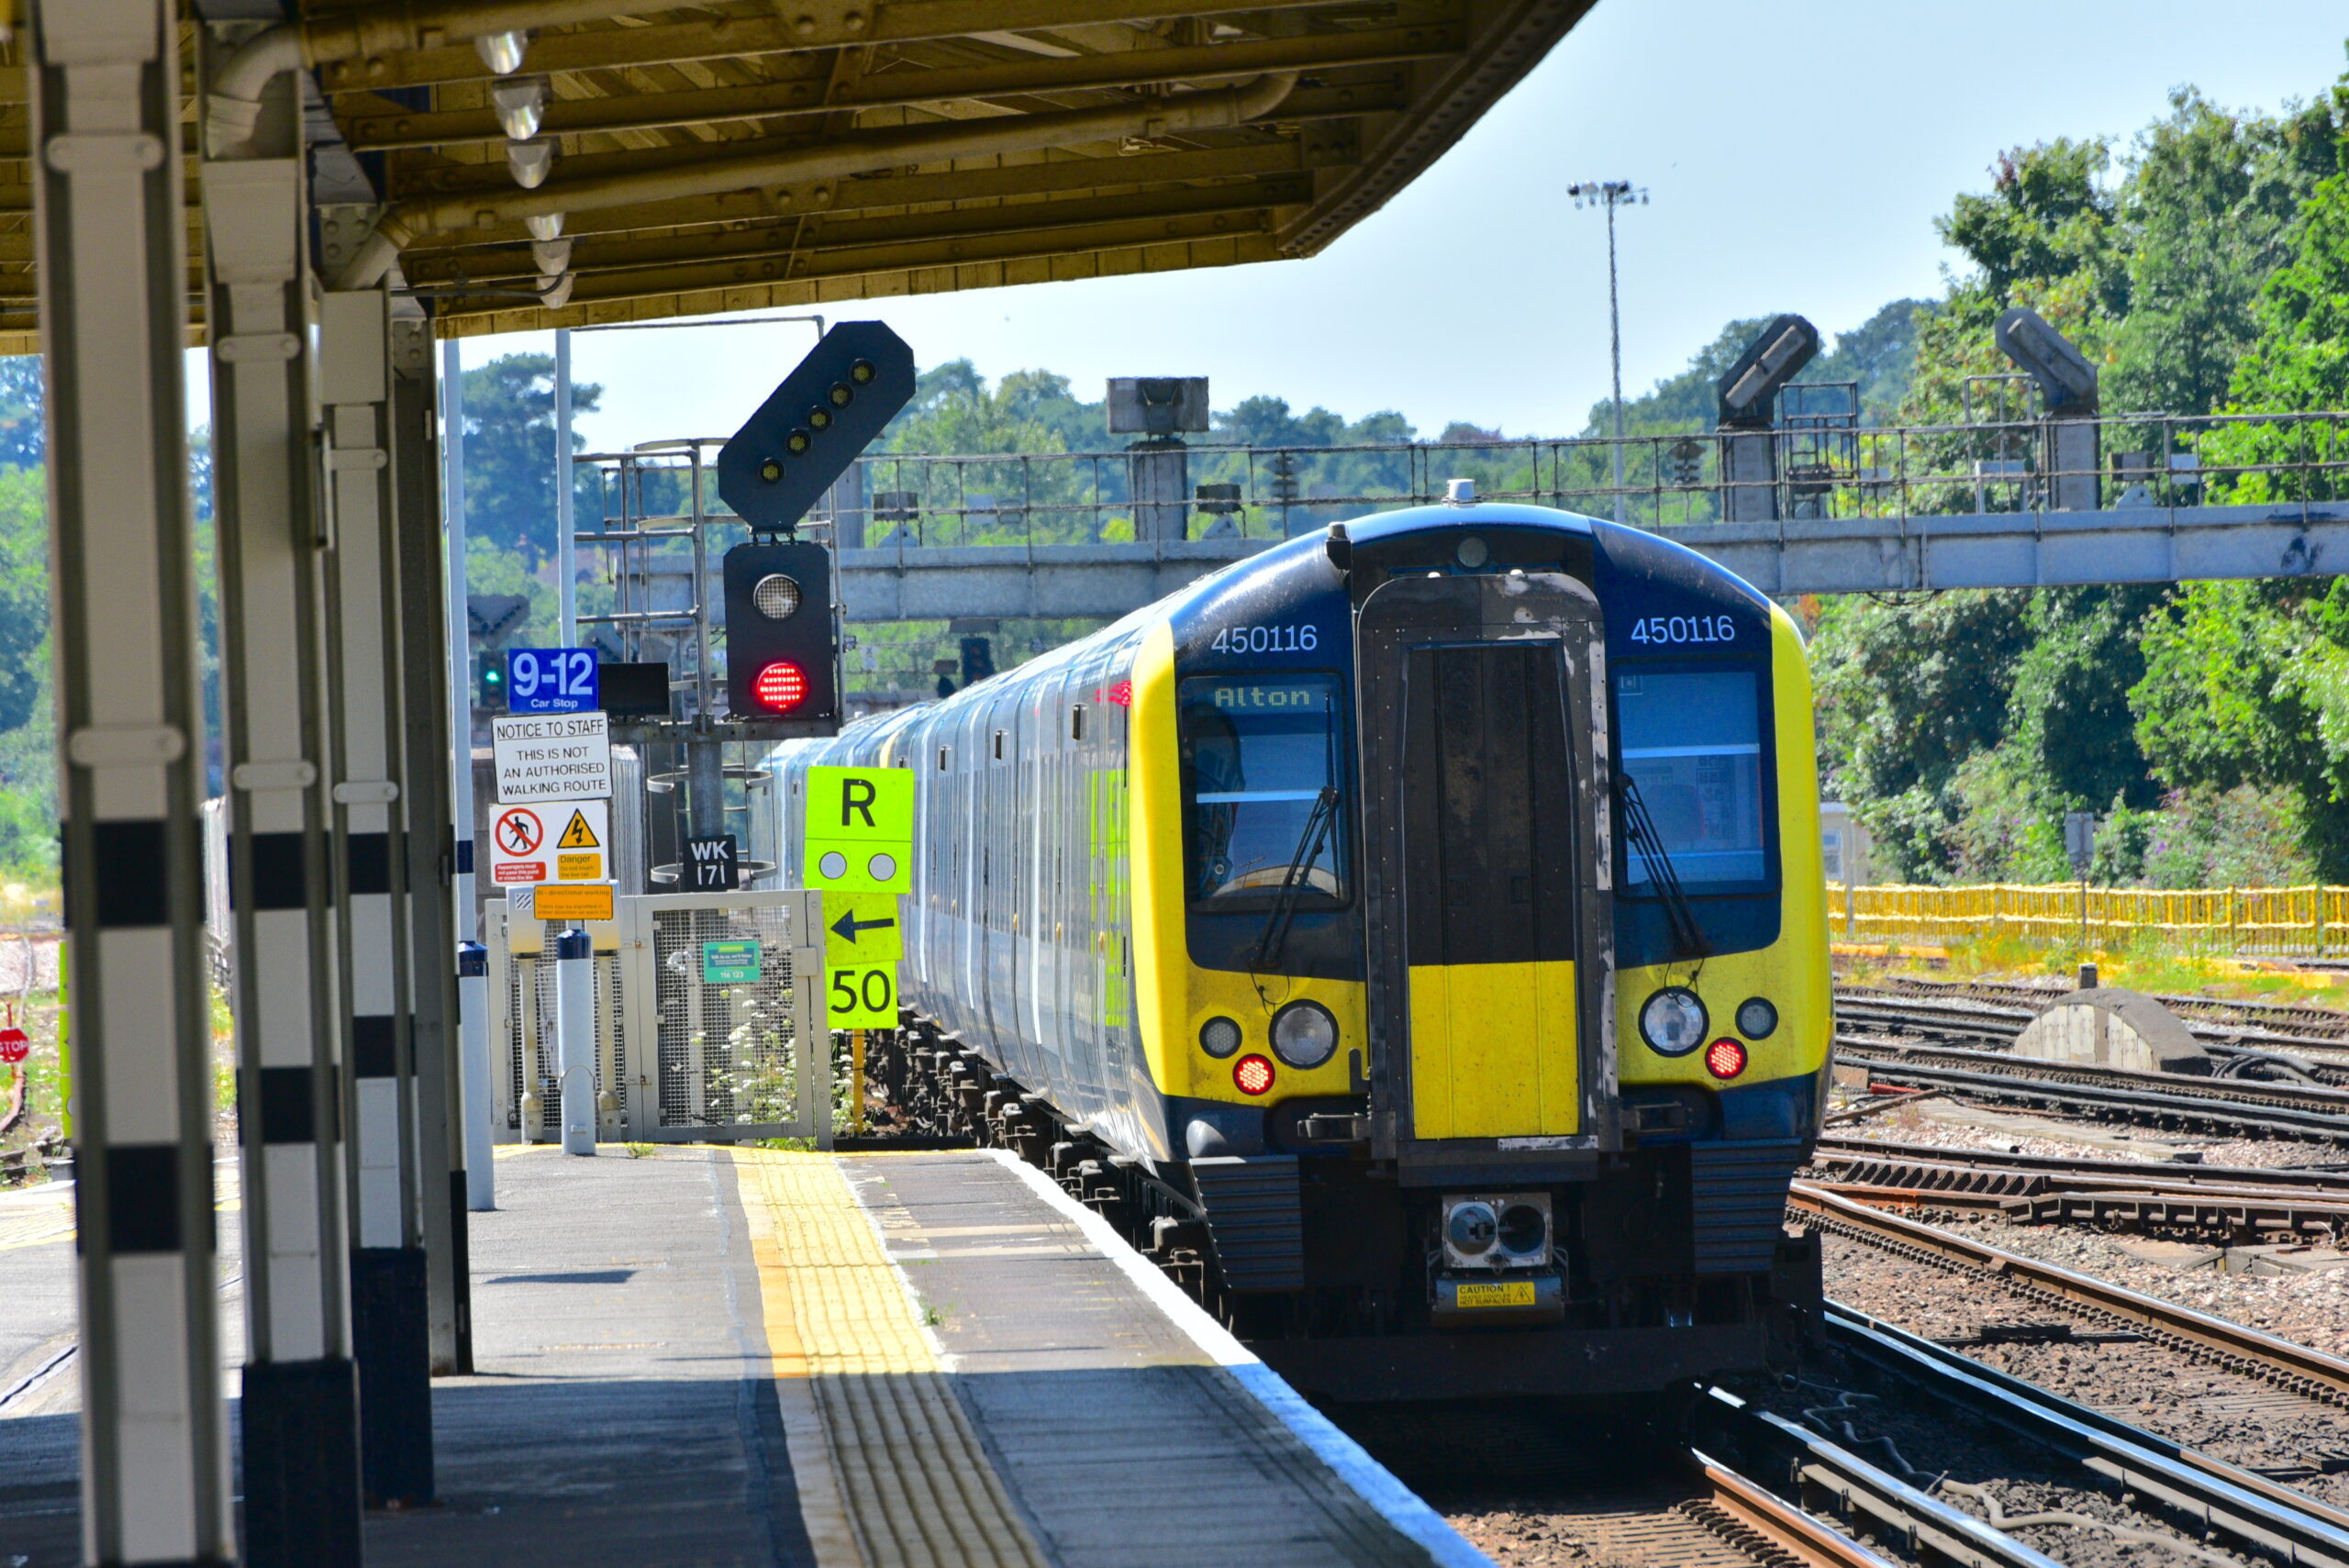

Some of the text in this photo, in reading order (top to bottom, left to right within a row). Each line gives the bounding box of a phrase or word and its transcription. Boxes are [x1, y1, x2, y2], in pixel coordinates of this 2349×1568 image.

[1210, 624, 1318, 654] 450116
[1631, 615, 1735, 644] 450116
[513, 652, 593, 696] 9-12
[530, 698, 578, 709] Car Stop
[1215, 686, 1309, 707] Alton
[496, 718, 604, 739] NOTICE TO STAFF
[516, 746, 590, 762] THIS IS NOT
[504, 762, 605, 779] AN AUTHORISED
[502, 779, 607, 796] WALKING ROUTE
[841, 778, 876, 827] R
[560, 855, 590, 864] Danger
[691, 840, 729, 861] WK
[697, 862, 726, 885] 171
[830, 969, 891, 1014] 50
[1460, 1285, 1504, 1294] CAUTION
